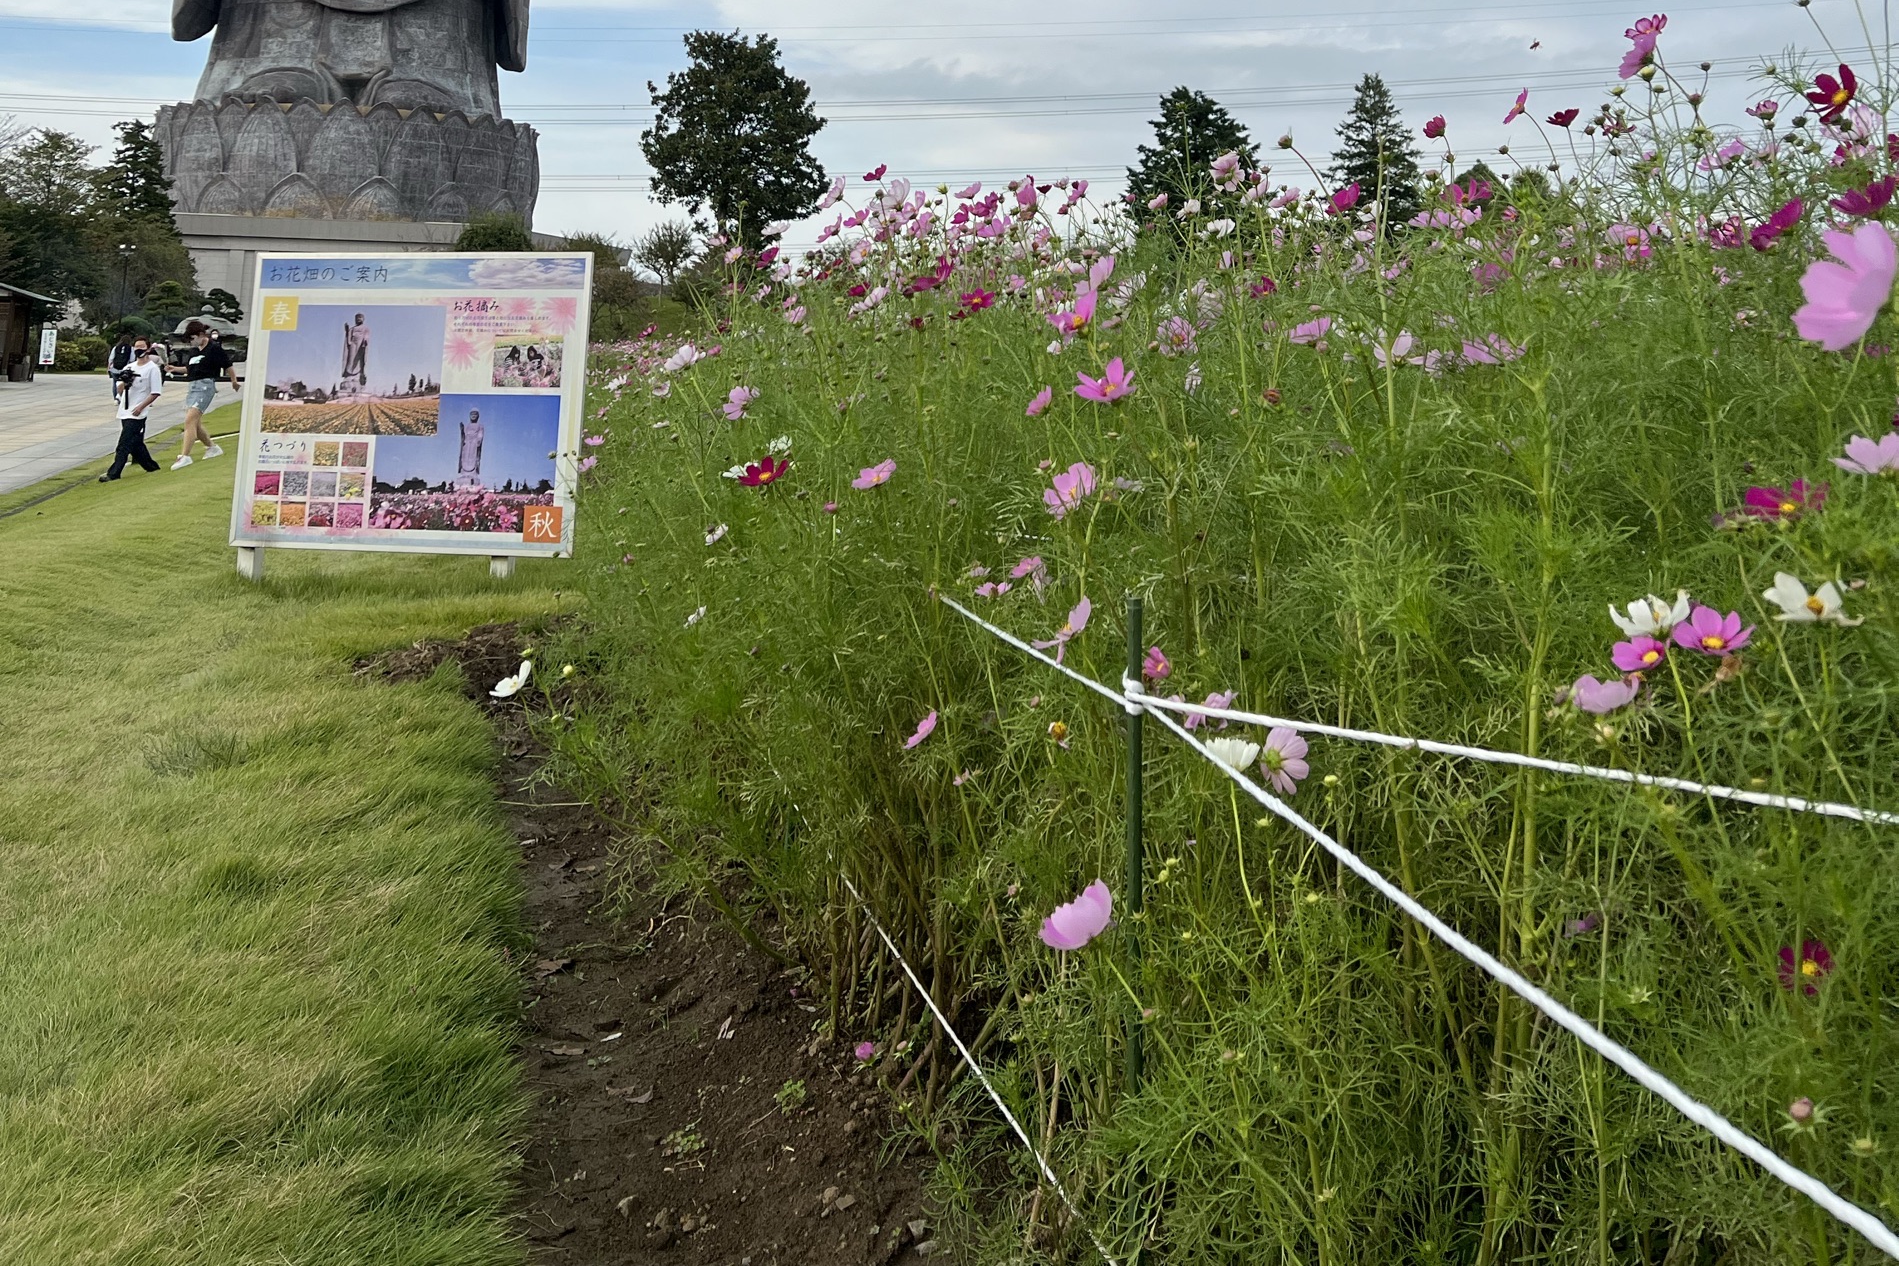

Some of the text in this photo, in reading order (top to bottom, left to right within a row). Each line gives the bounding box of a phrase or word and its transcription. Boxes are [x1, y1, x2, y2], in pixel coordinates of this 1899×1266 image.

[269, 265, 388, 283] お花畑のご案内
[267, 301, 291, 326] 春
[453, 299, 500, 313] お花摘み
[259, 438, 307, 453] 花つづり
[528, 511, 558, 539] 秋
